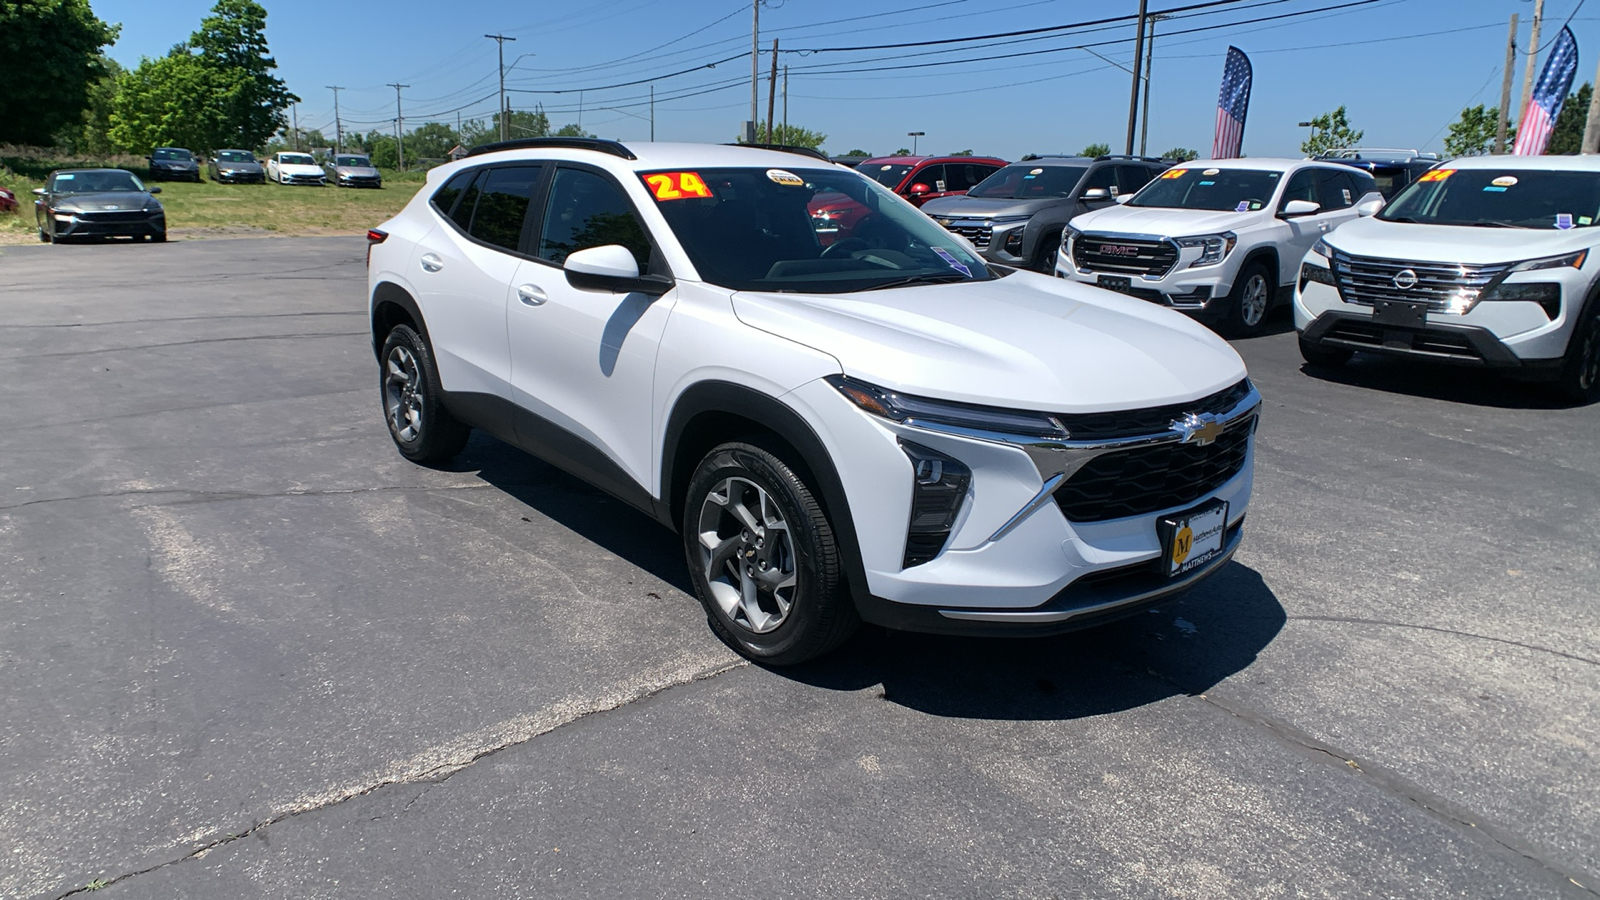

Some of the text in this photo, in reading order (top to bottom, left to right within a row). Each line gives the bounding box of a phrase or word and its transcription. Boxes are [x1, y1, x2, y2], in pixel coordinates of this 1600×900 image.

[1161, 169, 1187, 179] 24
[1420, 169, 1452, 181] 24
[647, 172, 707, 199] 24
[1100, 245, 1138, 256] GMC
[1176, 535, 1190, 557] M
[1182, 551, 1213, 572] MATTHEWS
